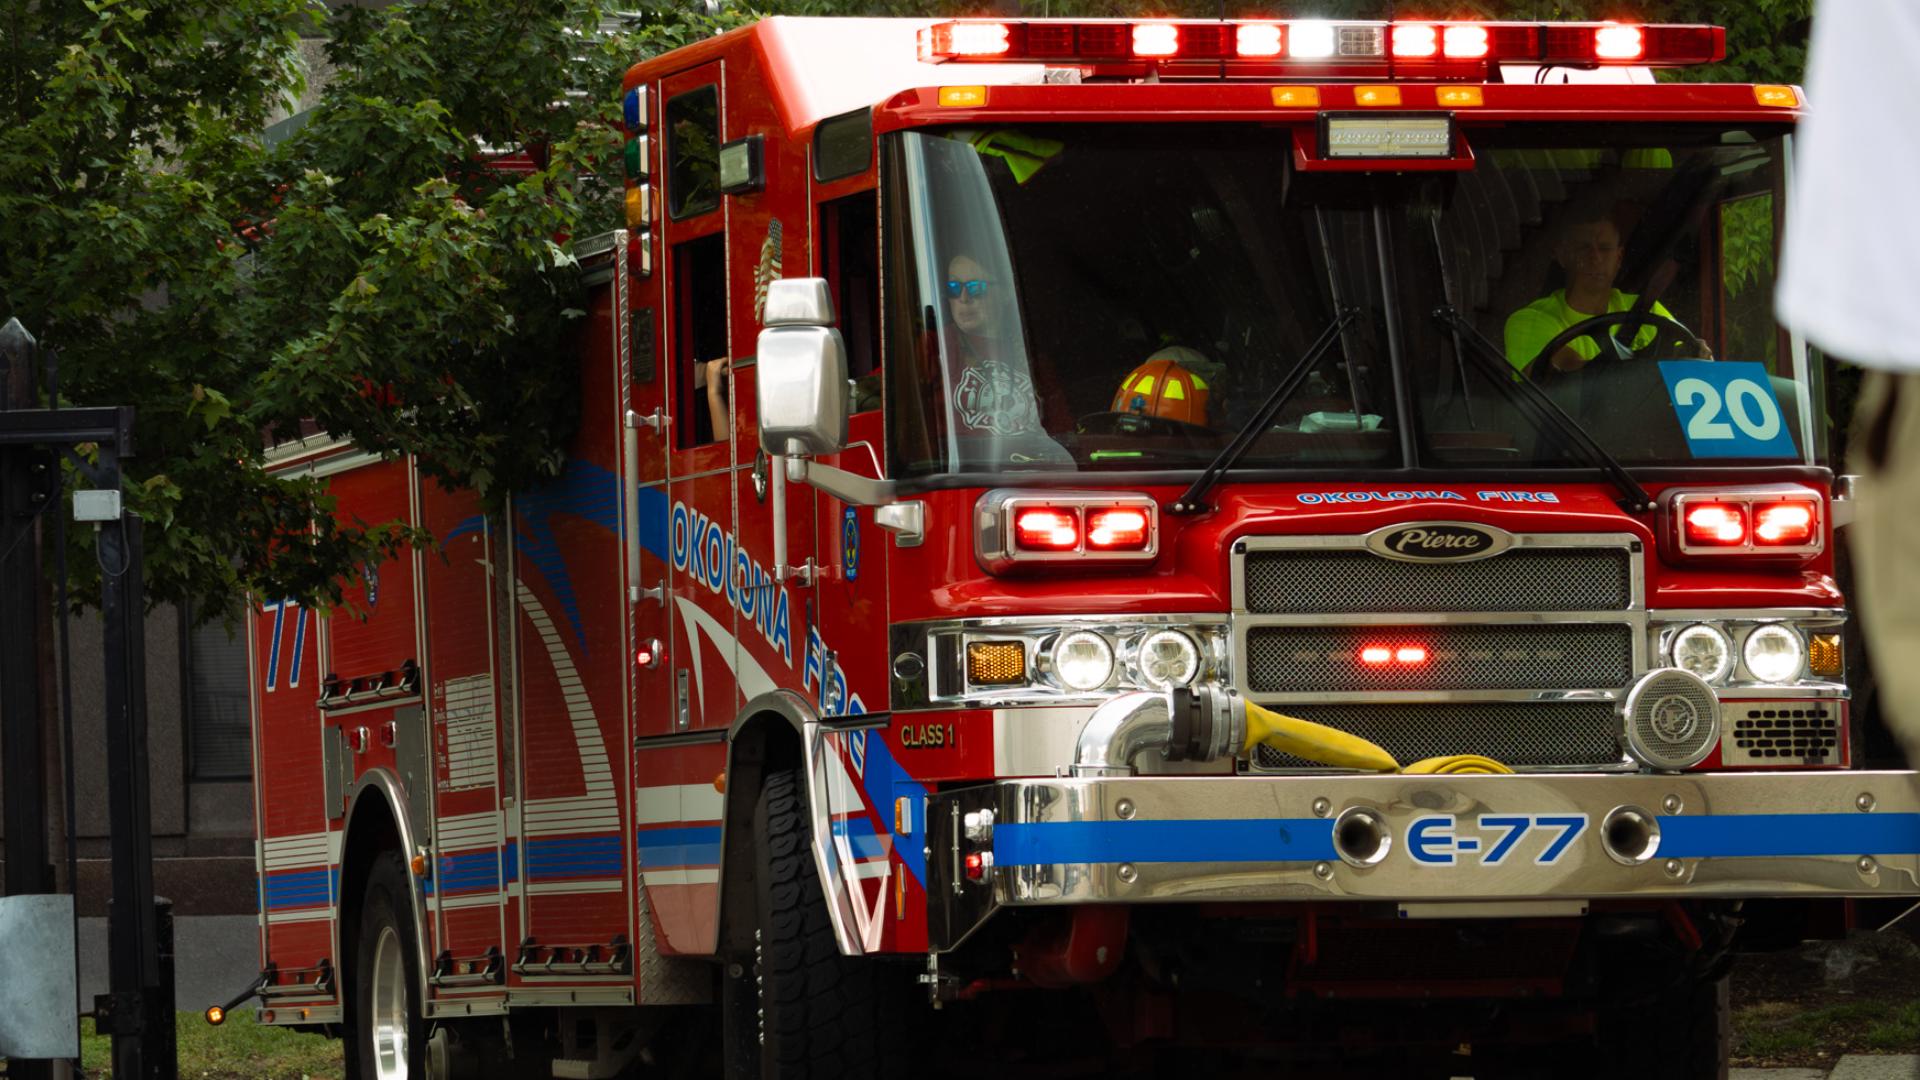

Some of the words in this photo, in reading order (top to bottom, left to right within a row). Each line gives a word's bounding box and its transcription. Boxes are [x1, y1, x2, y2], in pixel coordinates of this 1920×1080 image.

[1674, 378, 1781, 441] 20
[1296, 490, 1467, 505] OKOLONA
[1477, 491, 1560, 504] FIRE
[1396, 529, 1481, 552] Pierce
[672, 501, 793, 669] OKOLONA
[901, 723, 944, 747] CLASS
[947, 723, 954, 745] 1
[1404, 813, 1590, 867] E-77
